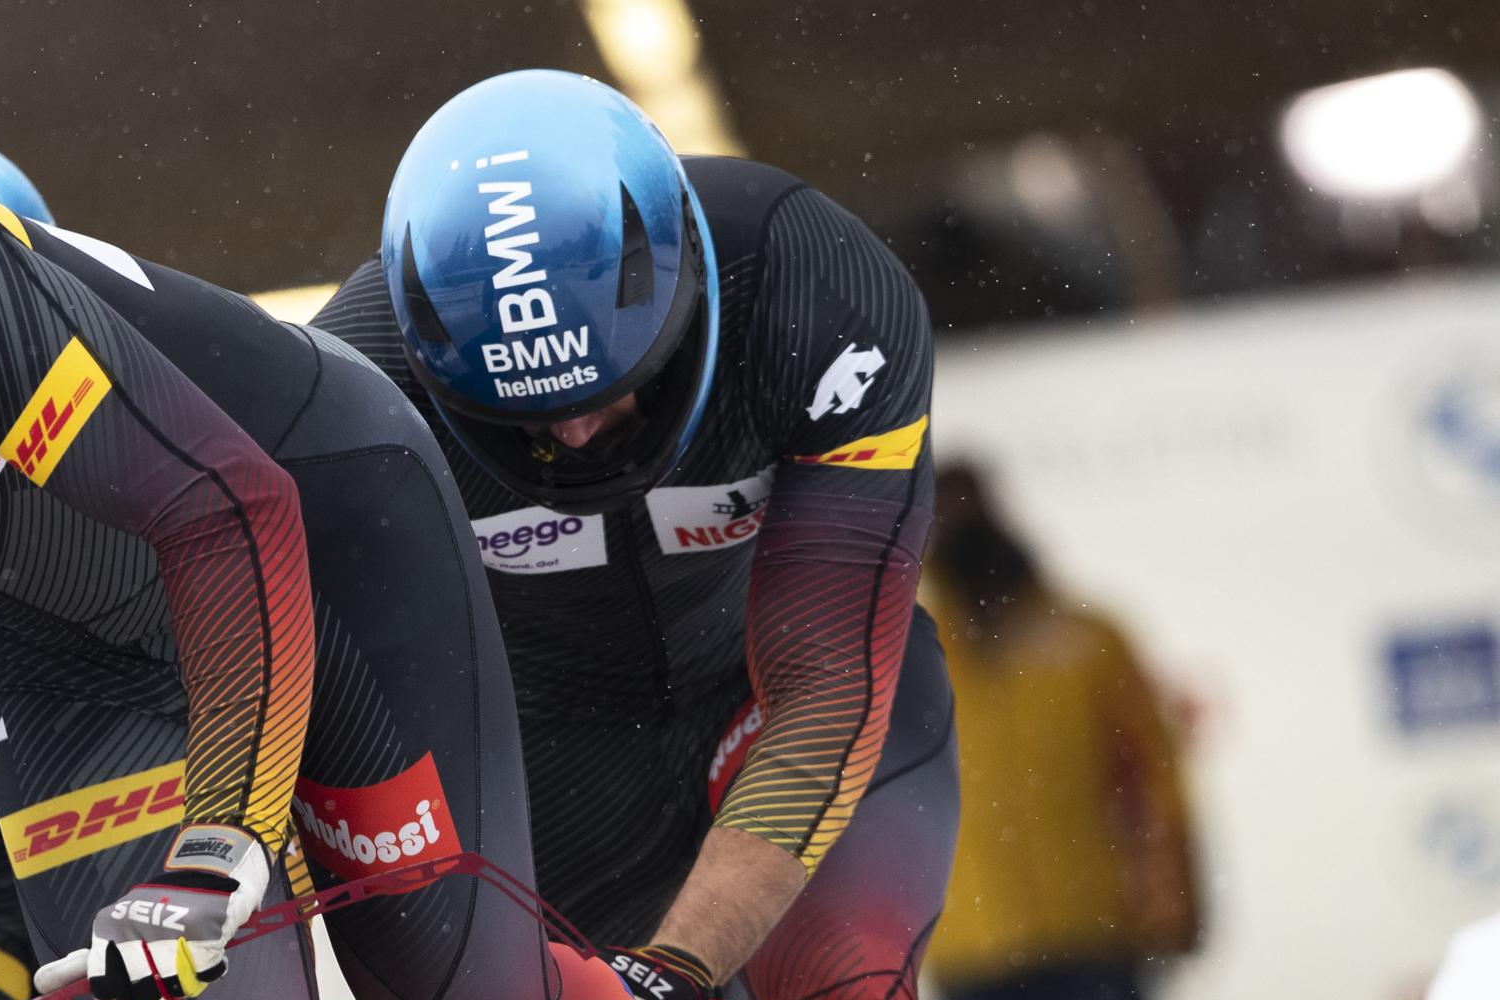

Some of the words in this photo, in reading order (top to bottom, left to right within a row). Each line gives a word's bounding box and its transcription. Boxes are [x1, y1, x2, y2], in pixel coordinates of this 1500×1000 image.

[478, 181, 558, 333] BMW
[481, 325, 589, 373] BMW
[494, 364, 598, 398] helmets
[24, 776, 185, 857] DHL
